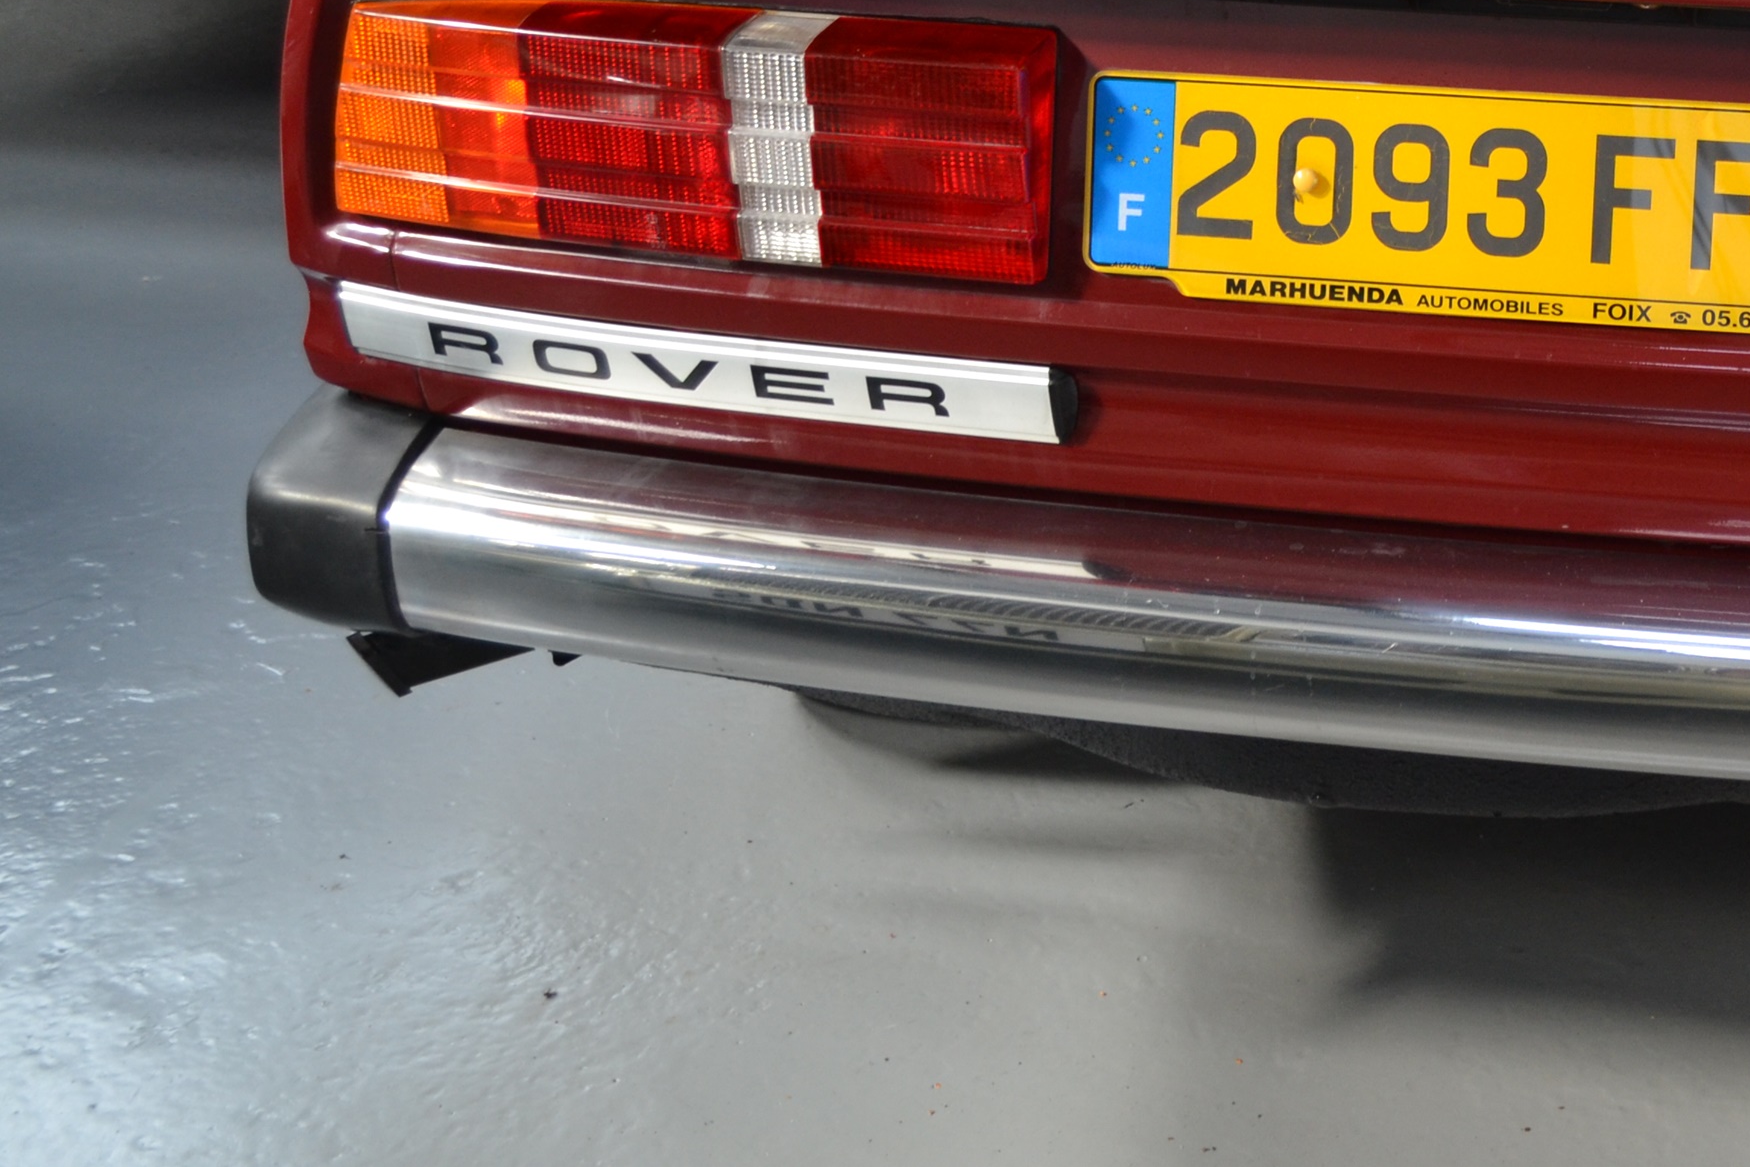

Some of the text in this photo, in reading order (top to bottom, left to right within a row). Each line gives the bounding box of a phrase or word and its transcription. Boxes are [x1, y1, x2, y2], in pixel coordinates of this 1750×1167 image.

[1117, 192, 1146, 232] F
[1177, 110, 1548, 257] 2093
[1225, 278, 1404, 306] MARHUENDA
[1416, 294, 1564, 316] AUTOMOBILES
[1592, 302, 1652, 323] FOIX
[427, 321, 951, 418] ROVER
